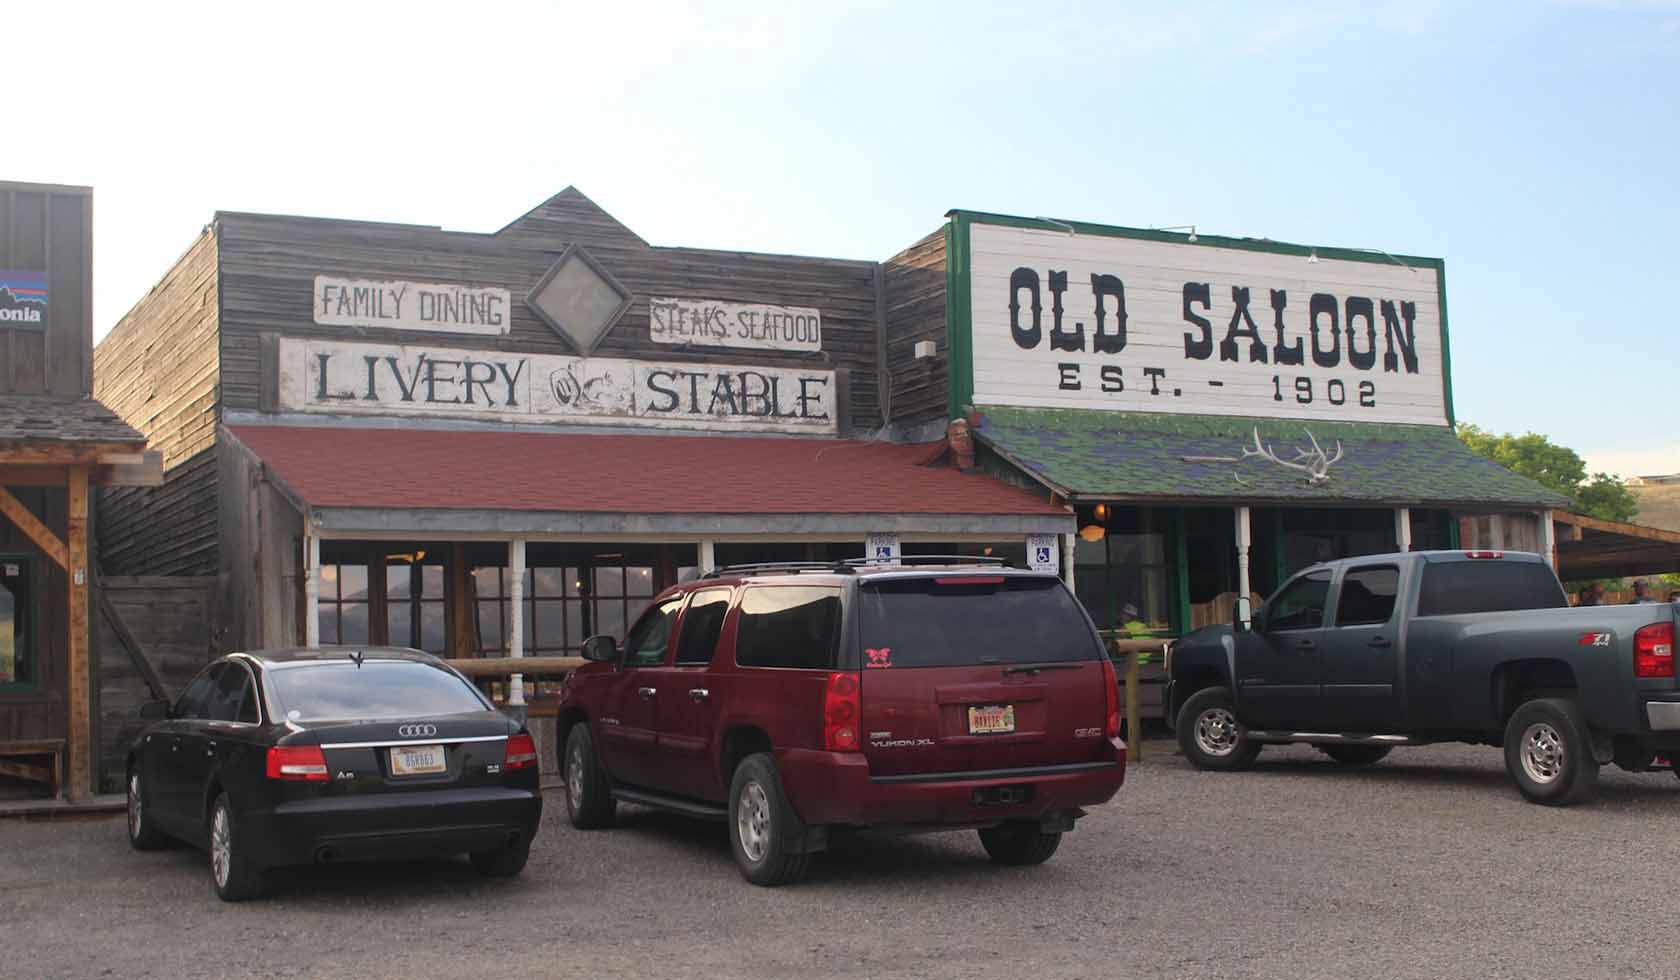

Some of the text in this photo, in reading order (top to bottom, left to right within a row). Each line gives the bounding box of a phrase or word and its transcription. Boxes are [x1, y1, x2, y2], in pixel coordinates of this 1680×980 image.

[322, 284, 504, 326] FAMILY DINING
[1008, 266, 1420, 374] OLD SALOON
[315, 352, 829, 420] LIVERY STABLE
[1057, 362, 1182, 397] EST.
[1272, 375, 1376, 408] 1902
[871, 738, 936, 748] YUKON XL
